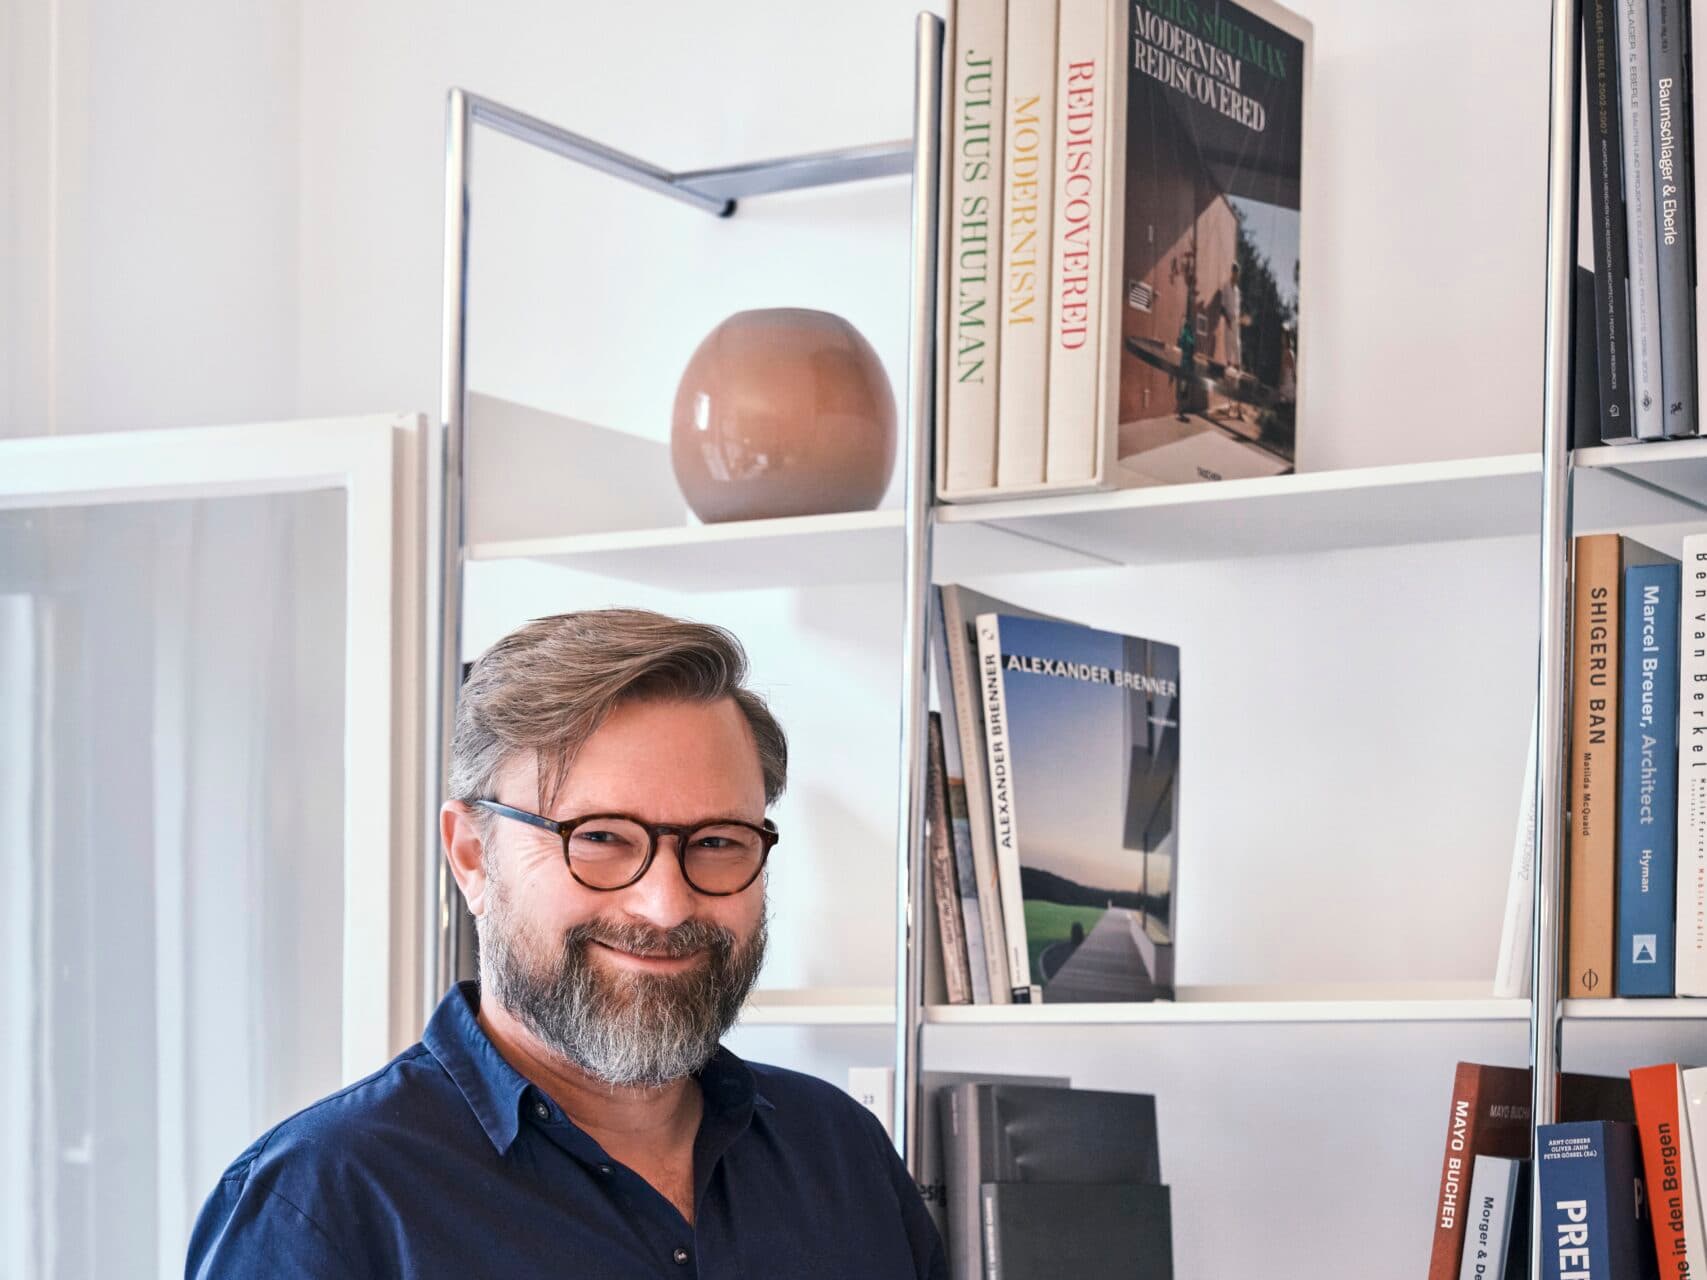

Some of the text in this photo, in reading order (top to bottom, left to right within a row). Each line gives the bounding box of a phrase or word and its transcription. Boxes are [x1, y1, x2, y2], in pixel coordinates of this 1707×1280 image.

[1134, 38, 1266, 132] REDISCOVERED
[1135, 4, 1241, 89] MODERNISM
[1061, 59, 1095, 350] REDISCOVERED
[1658, 78, 1678, 246] Baumschlager & Eberle
[957, 49, 993, 384] JULIUS SHULMAN
[1008, 95, 1041, 326] MODERNISM
[1695, 553, 1707, 598] Ben
[1007, 653, 1178, 698] ALEXANDER BRENNER
[1588, 587, 1608, 745] SHIGERU BAN
[1694, 614, 1706, 658] van
[985, 653, 1012, 849] ALEXANDER BRENNER
[1639, 585, 1659, 893] Marcel Breuer, Architect Hyman
[1692, 673, 1707, 769] Berkel
[1582, 752, 1592, 837] Matilda McQuaid
[1440, 1100, 1469, 1230] MAYO BUCHER
[1658, 1122, 1681, 1194] Bergen
[1478, 1248, 1489, 1260] &
[1479, 1196, 1494, 1240] Morger
[1668, 1196, 1686, 1231] den
[1673, 1238, 1687, 1255] in
